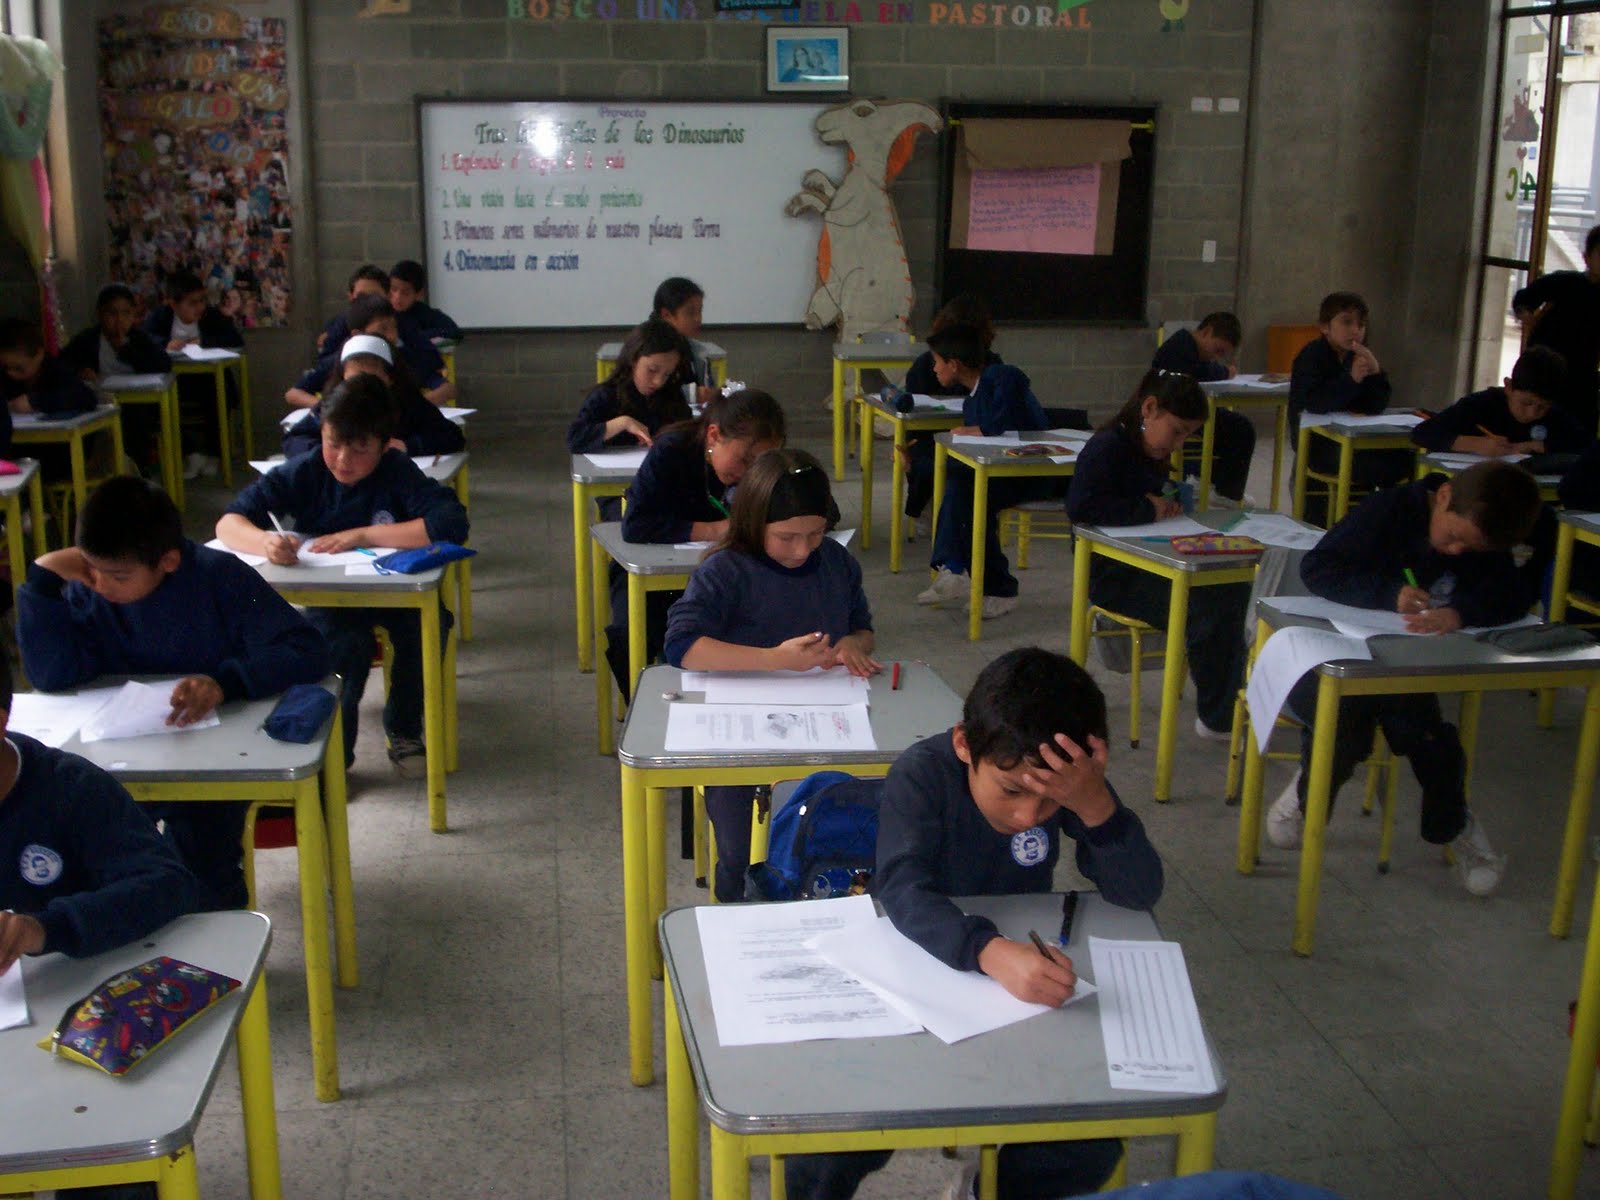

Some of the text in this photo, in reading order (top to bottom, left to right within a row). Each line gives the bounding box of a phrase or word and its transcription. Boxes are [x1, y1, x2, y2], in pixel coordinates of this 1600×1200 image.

[507, 0, 618, 20] BOSCO
[637, 0, 698, 20] UNA
[880, 3, 915, 24] EN
[929, 4, 1092, 28] PASTORAL
[475, 121, 506, 144] Tras
[604, 119, 621, 144] de
[634, 119, 653, 144] los
[662, 121, 745, 144] Dinosaurios
[586, 216, 598, 239] de
[525, 254, 538, 271] en
